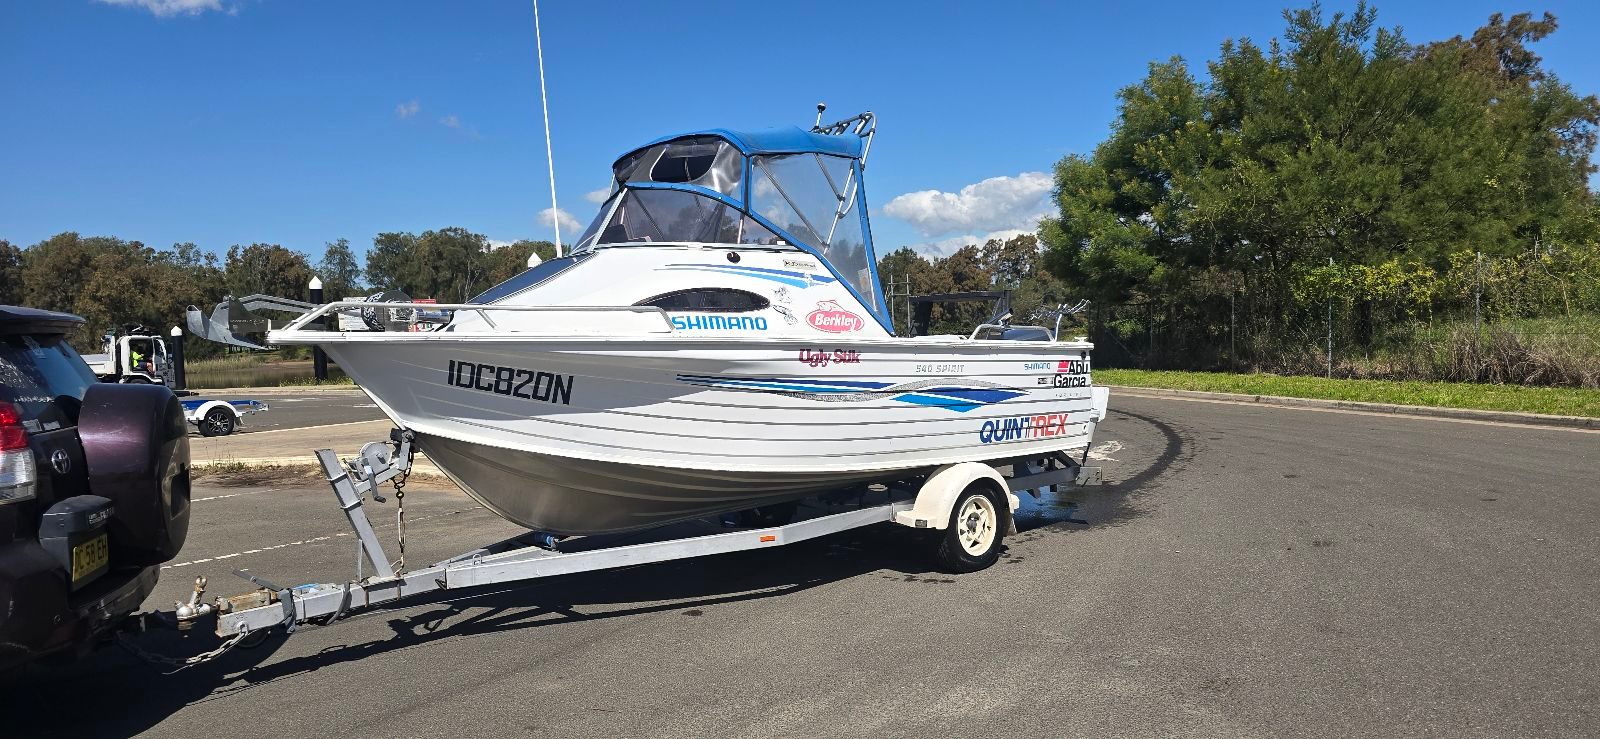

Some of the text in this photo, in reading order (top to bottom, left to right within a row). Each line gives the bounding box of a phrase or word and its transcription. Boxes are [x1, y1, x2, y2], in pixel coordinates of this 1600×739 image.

[671, 315, 768, 331] SHIMANO
[814, 313, 858, 331] Berkley
[799, 348, 861, 367] Ugly Stik
[936, 364, 965, 373] SPIRIT
[1024, 362, 1051, 371] SHIMANO
[1068, 359, 1089, 375] Abu
[1053, 373, 1087, 388] Garcia
[980, 413, 1069, 444] QUINTREX
